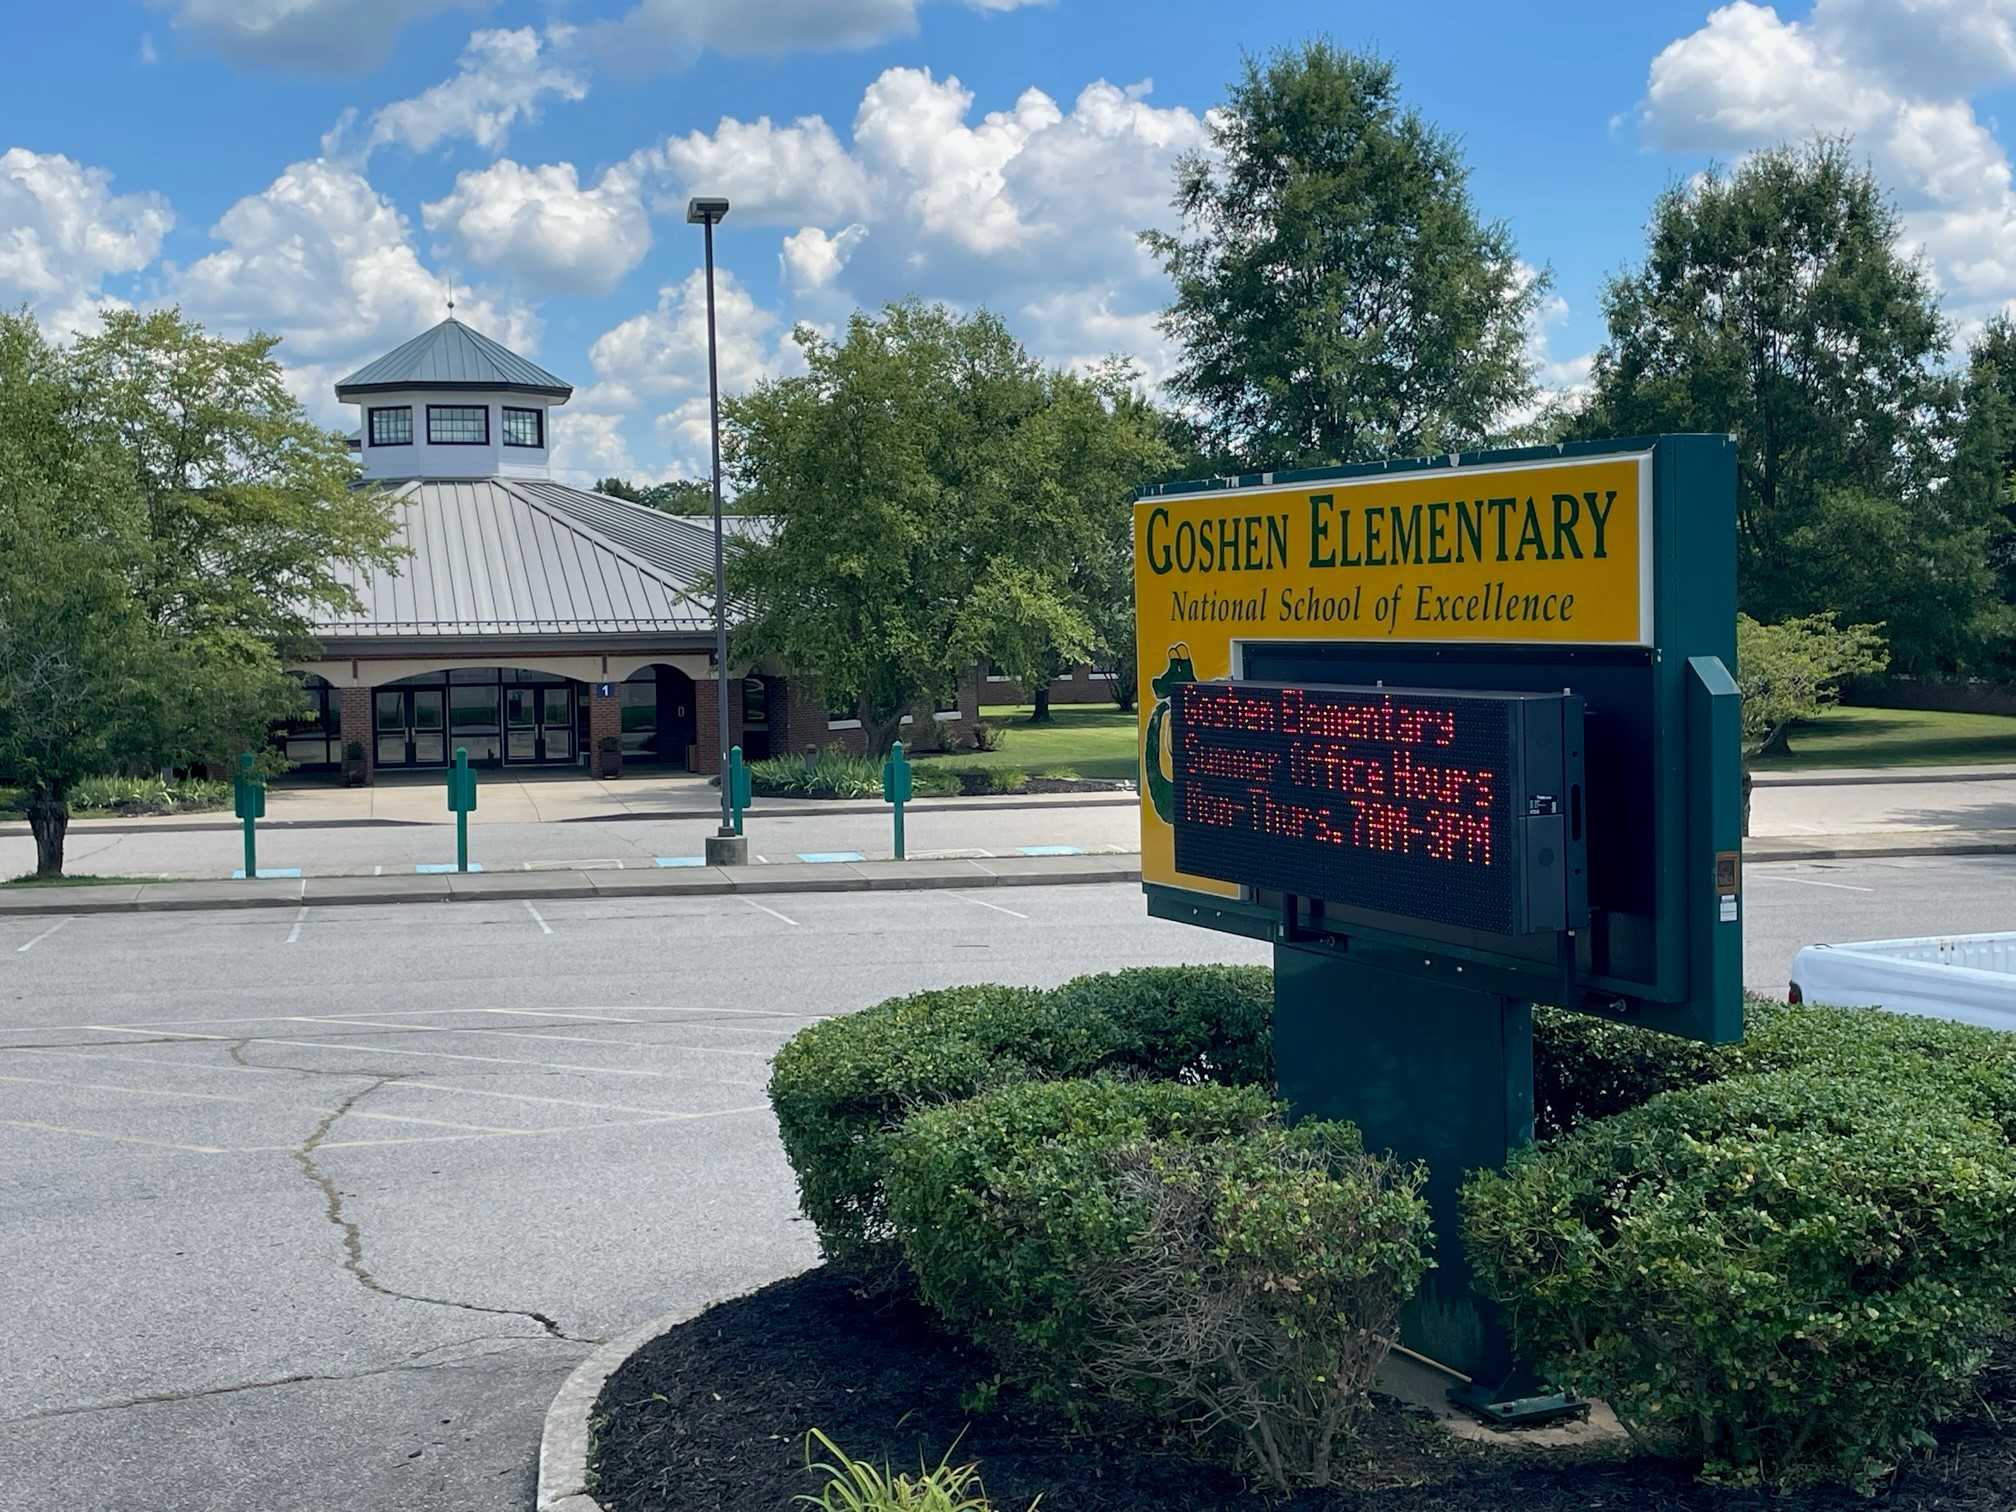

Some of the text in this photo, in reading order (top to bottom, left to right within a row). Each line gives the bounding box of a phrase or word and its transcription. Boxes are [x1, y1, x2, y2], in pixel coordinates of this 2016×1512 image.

[1147, 491, 1617, 575] GOSHEN ELEMENTARY
[1171, 582, 1574, 635] National School of Excellence
[602, 685, 608, 696] 1
[1184, 683, 1454, 745] Goshen Elementary
[1184, 733, 1493, 807] Summer Office Hours
[1350, 800, 1491, 866] 7AM-3PM
